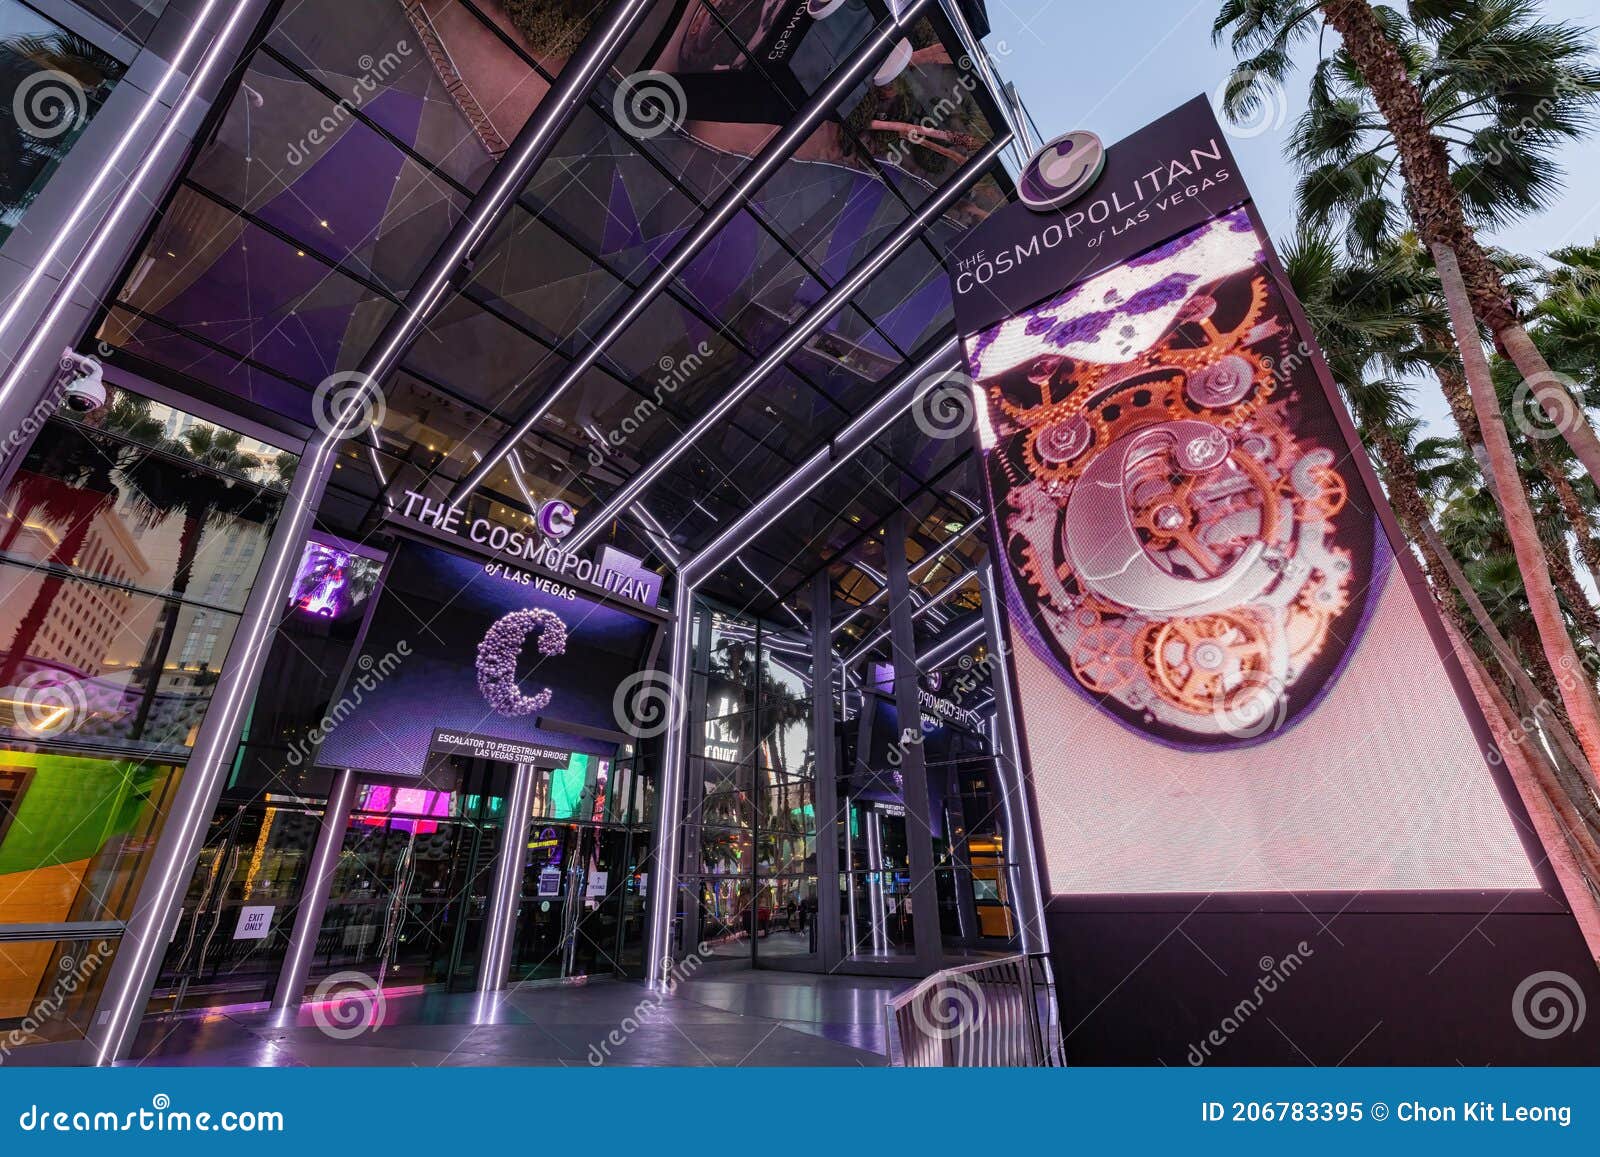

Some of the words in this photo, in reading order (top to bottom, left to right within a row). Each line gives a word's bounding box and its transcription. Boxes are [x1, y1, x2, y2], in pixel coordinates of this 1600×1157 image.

[956, 139, 1223, 295] COSMOPOLITAN
[1087, 230, 1105, 248] of
[1112, 210, 1150, 236] LAS
[1156, 169, 1229, 211] VEGAS
[955, 250, 986, 272] THE
[403, 490, 465, 534] THE
[470, 519, 651, 604] COSMOPOLITAN
[484, 562, 502, 576] of
[503, 568, 531, 585] LAS
[534, 579, 577, 600] VEGAS
[438, 733, 484, 748] ESCALATOR
[486, 741, 496, 750] TO
[497, 743, 542, 757] PEDESTRIAN
[543, 750, 569, 761] BRIDGE
[475, 748, 490, 757] LAS
[490, 750, 513, 761] VEGAS
[513, 754, 536, 764] STRIP
[244, 922, 263, 931] ONLY
[248, 913, 264, 922] EXIT
